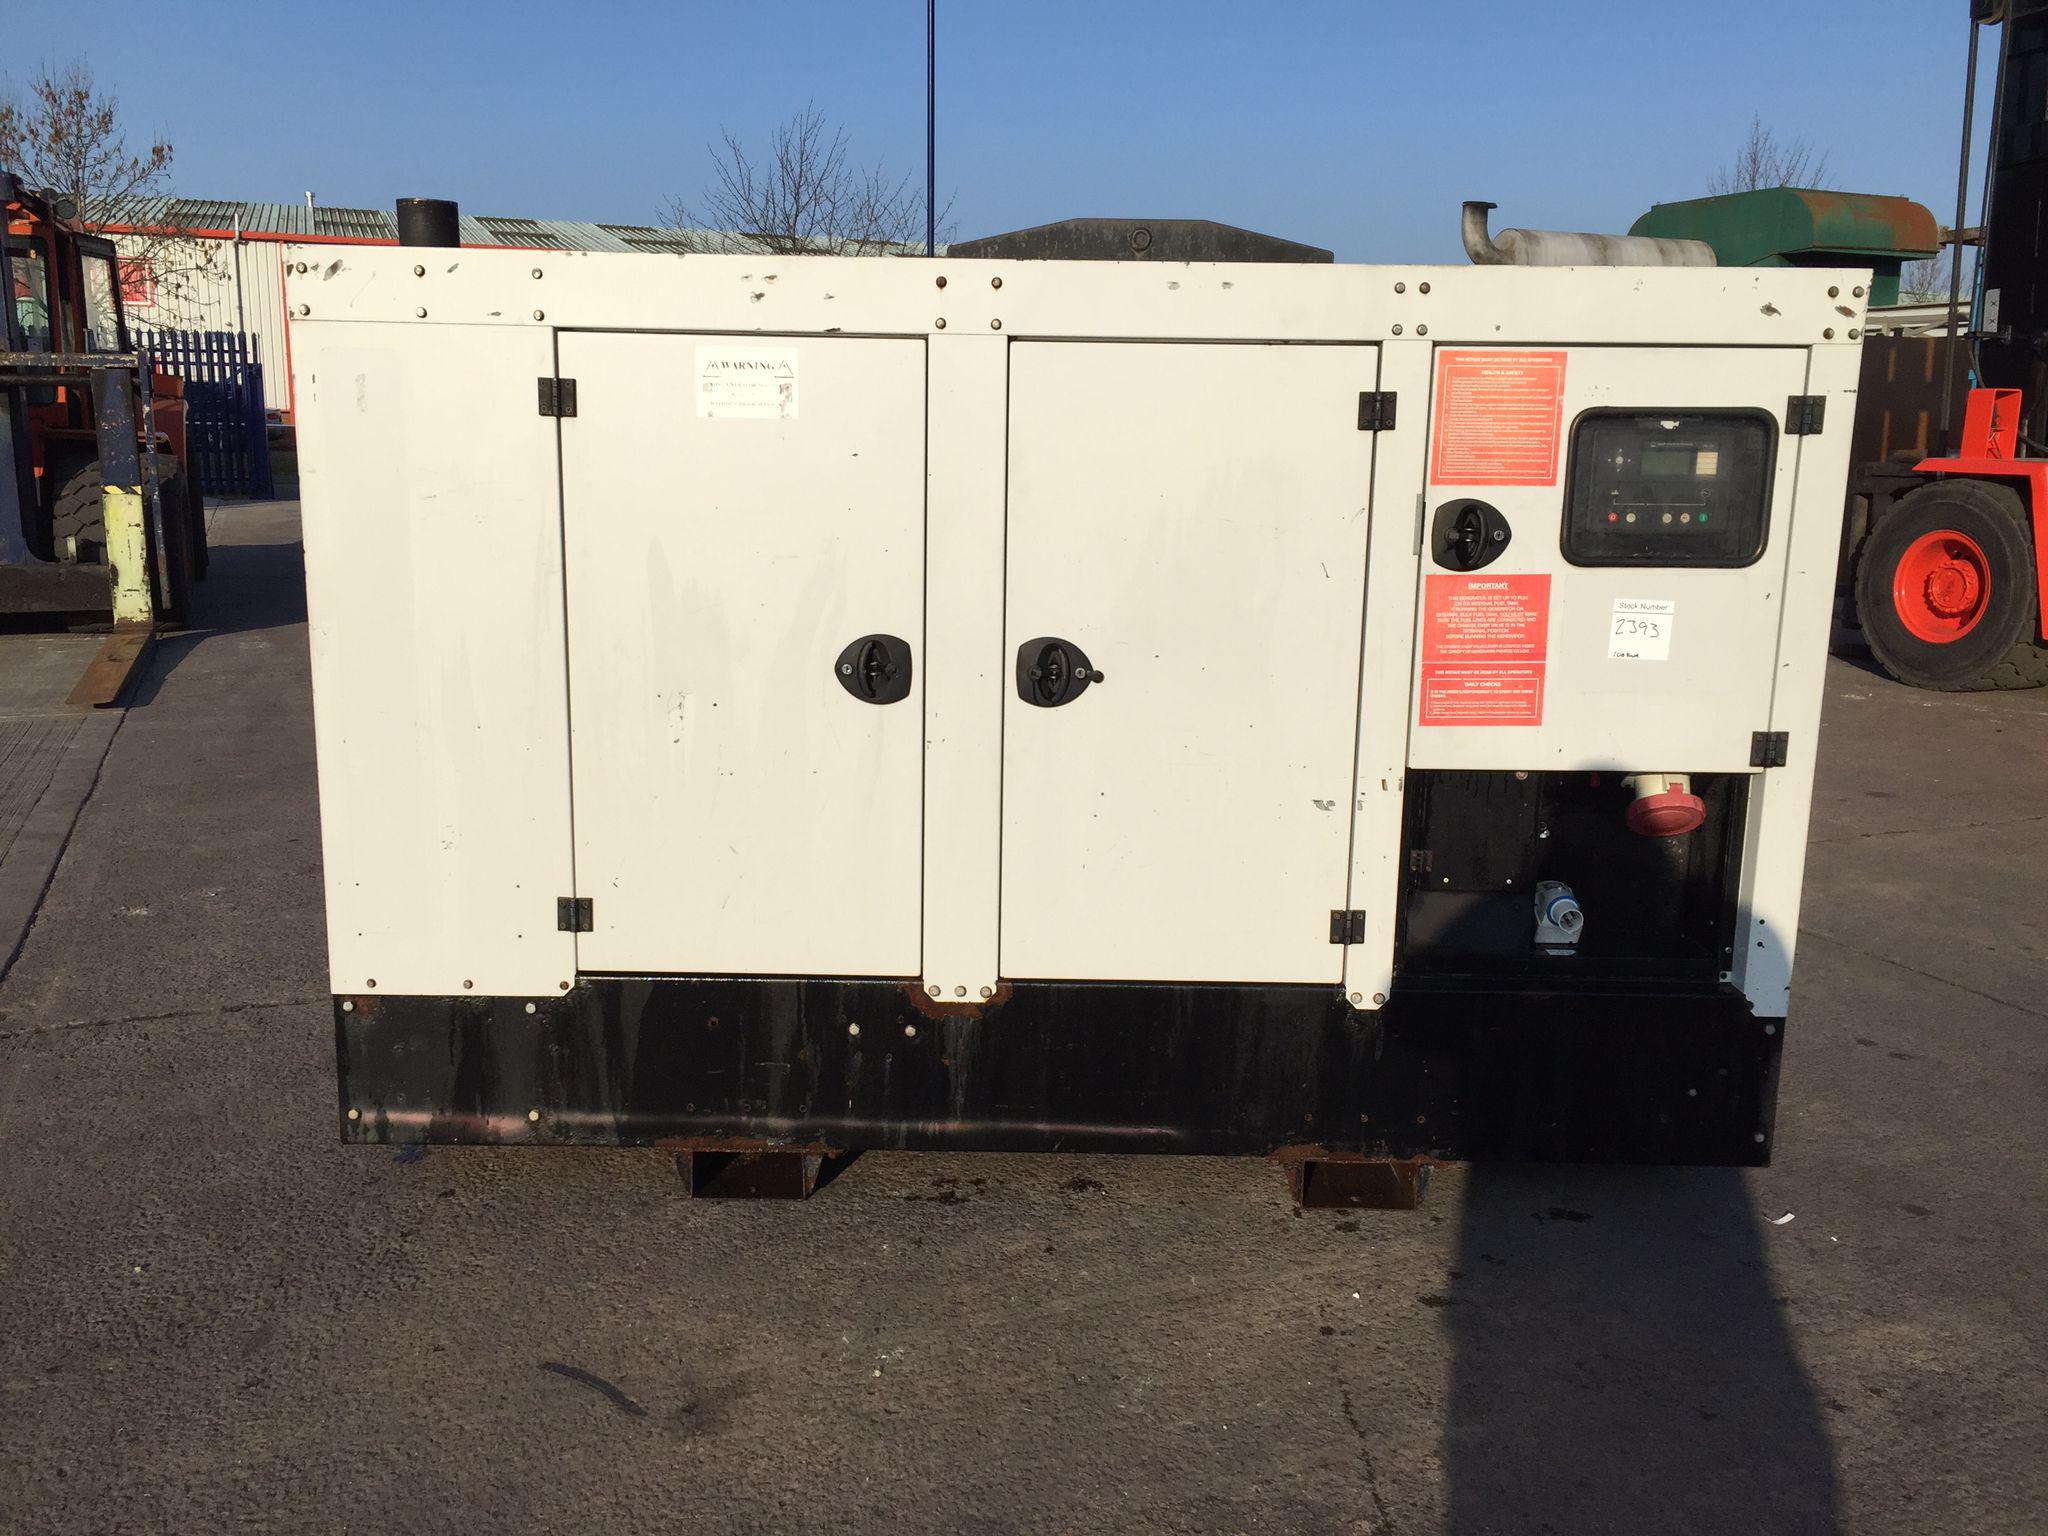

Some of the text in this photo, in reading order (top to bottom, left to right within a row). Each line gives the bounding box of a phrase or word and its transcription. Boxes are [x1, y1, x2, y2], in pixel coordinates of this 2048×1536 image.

[721, 361, 775, 370] WARNING
[1468, 582, 1509, 590] IMPORTANT
[1616, 619, 1659, 638] 2393
